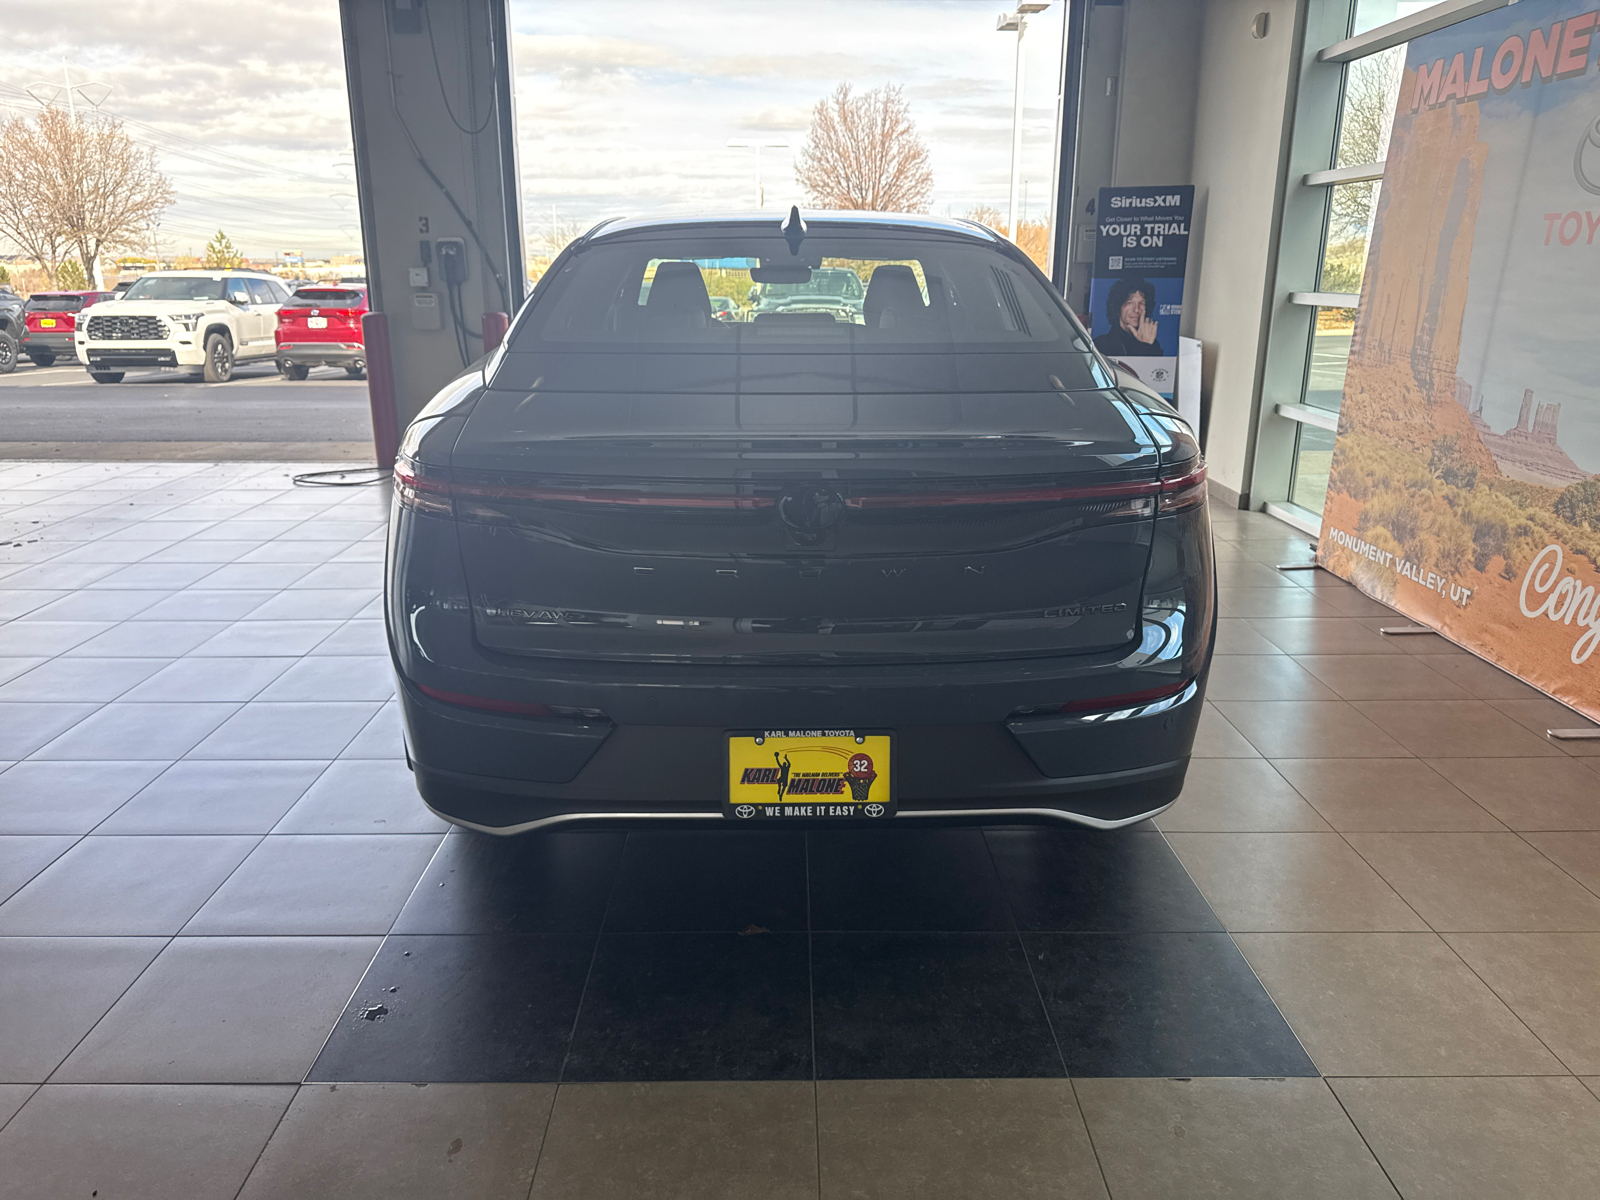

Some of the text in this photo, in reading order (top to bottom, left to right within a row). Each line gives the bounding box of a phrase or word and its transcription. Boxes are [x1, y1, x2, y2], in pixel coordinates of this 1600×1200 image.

[1410, 9, 1600, 114] MALONE
[1085, 197, 1096, 216] 4
[1110, 194, 1181, 208] SiriusXM
[418, 216, 430, 234] 3
[1099, 223, 1141, 237] YOUR
[1144, 222, 1189, 236] TRIAL
[1122, 235, 1164, 248] IS ON
[1328, 526, 1471, 606] MONUMENT VALLEY, UT
[1044, 602, 1127, 618] LIMITED
[764, 730, 786, 738] KARL
[853, 759, 868, 772] 32
[740, 768, 780, 784] KARL
[786, 778, 846, 795] MALONE
[765, 805, 855, 816] WE MAKE IT EASY
